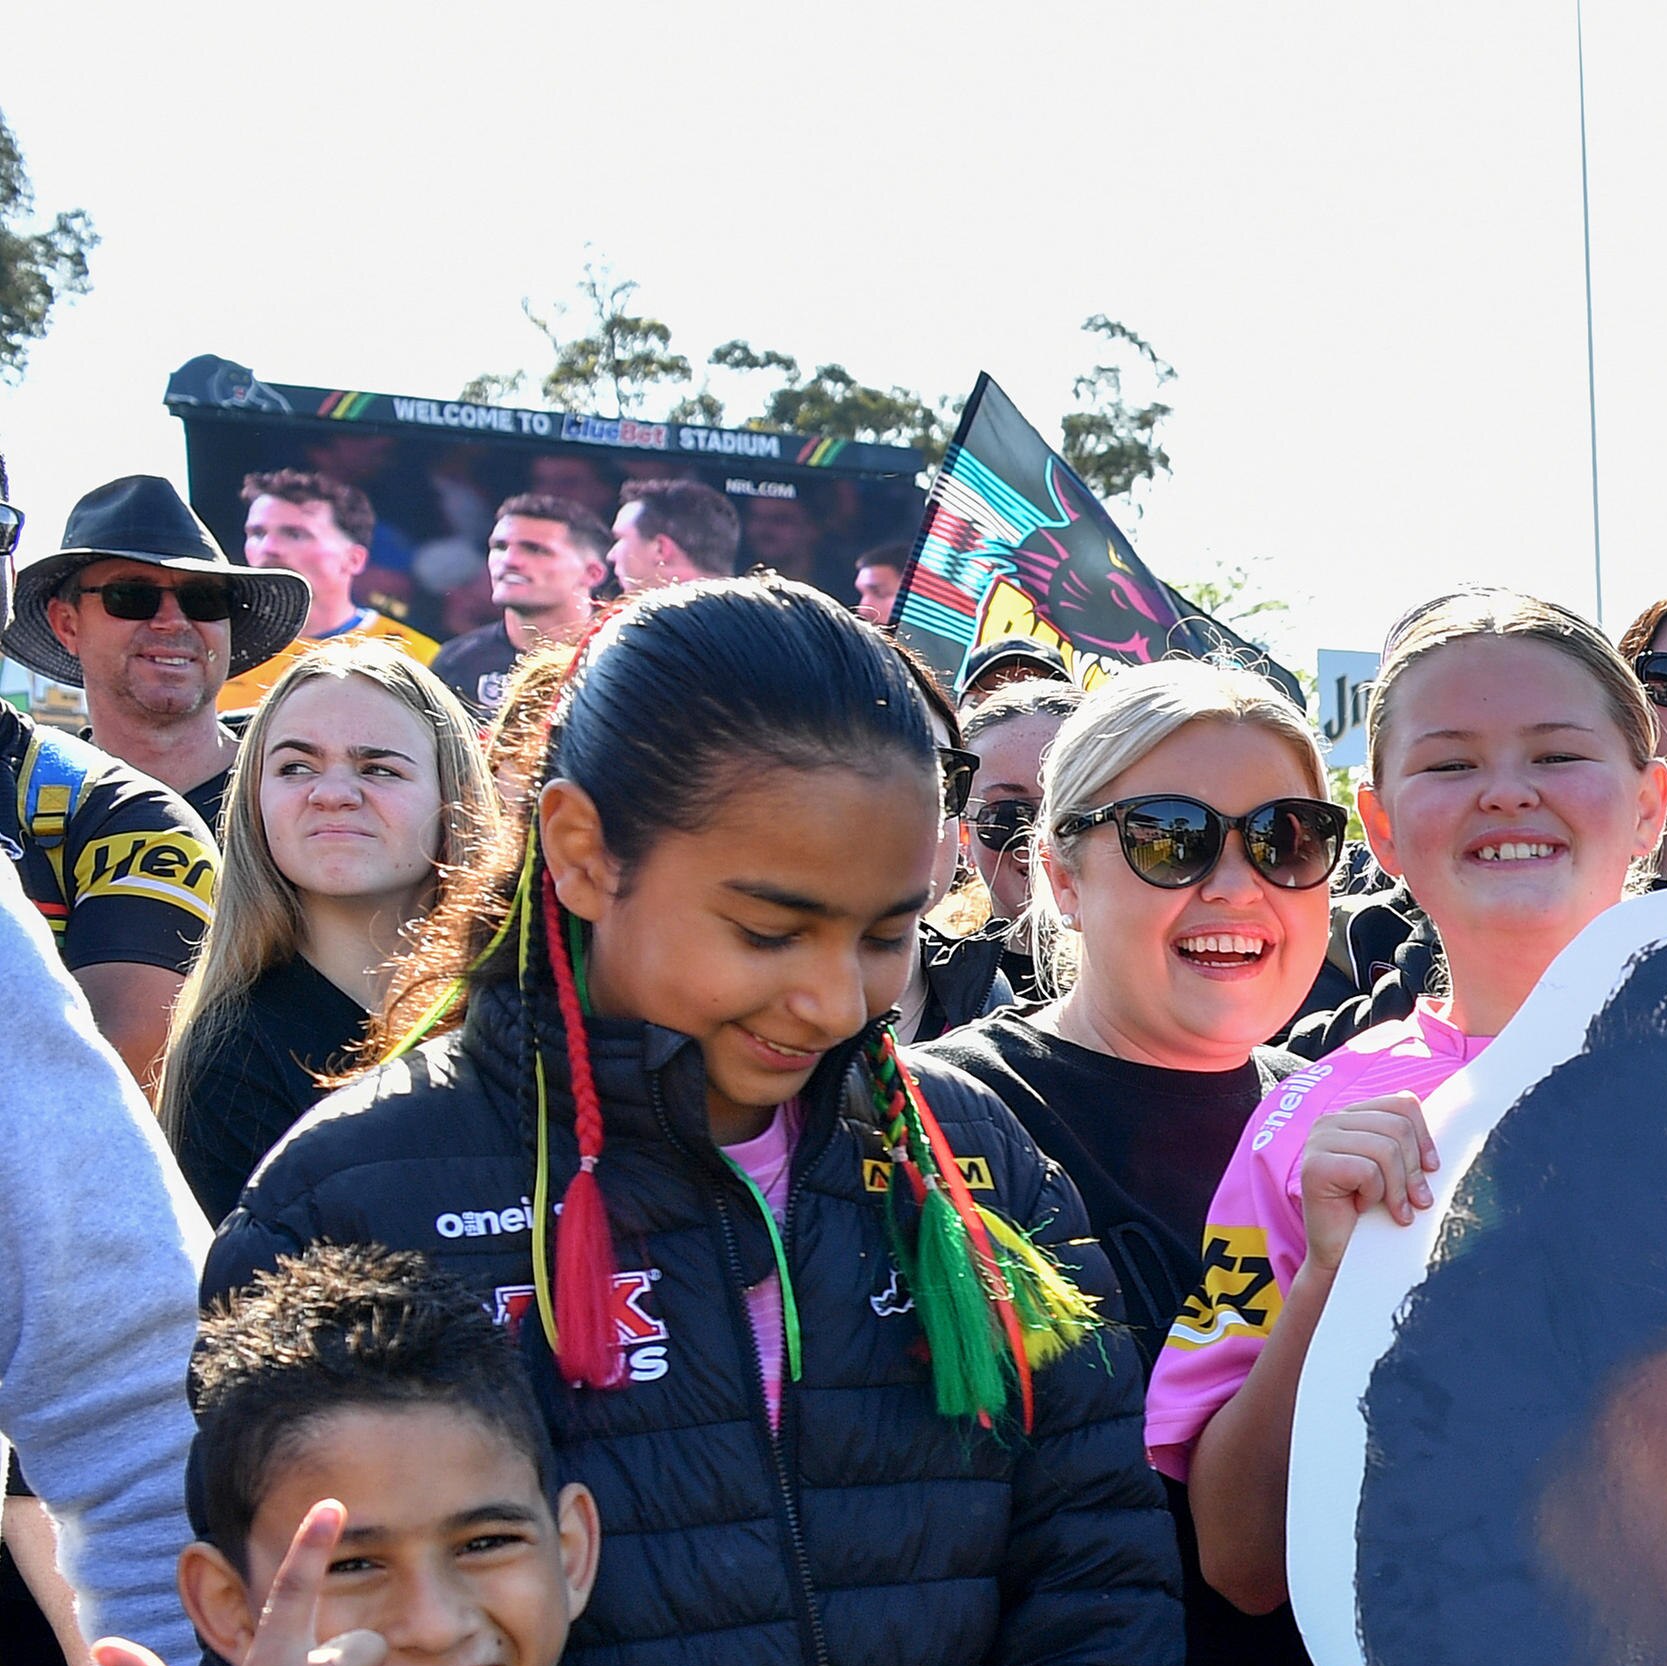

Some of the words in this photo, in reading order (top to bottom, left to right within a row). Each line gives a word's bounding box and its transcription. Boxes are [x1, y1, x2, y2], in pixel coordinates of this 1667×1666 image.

[393, 397, 513, 431] WELCOME
[517, 410, 551, 435] TO
[679, 428, 781, 458] STADIUM
[725, 478, 797, 499] NRL.COM
[91, 838, 214, 889] Her
